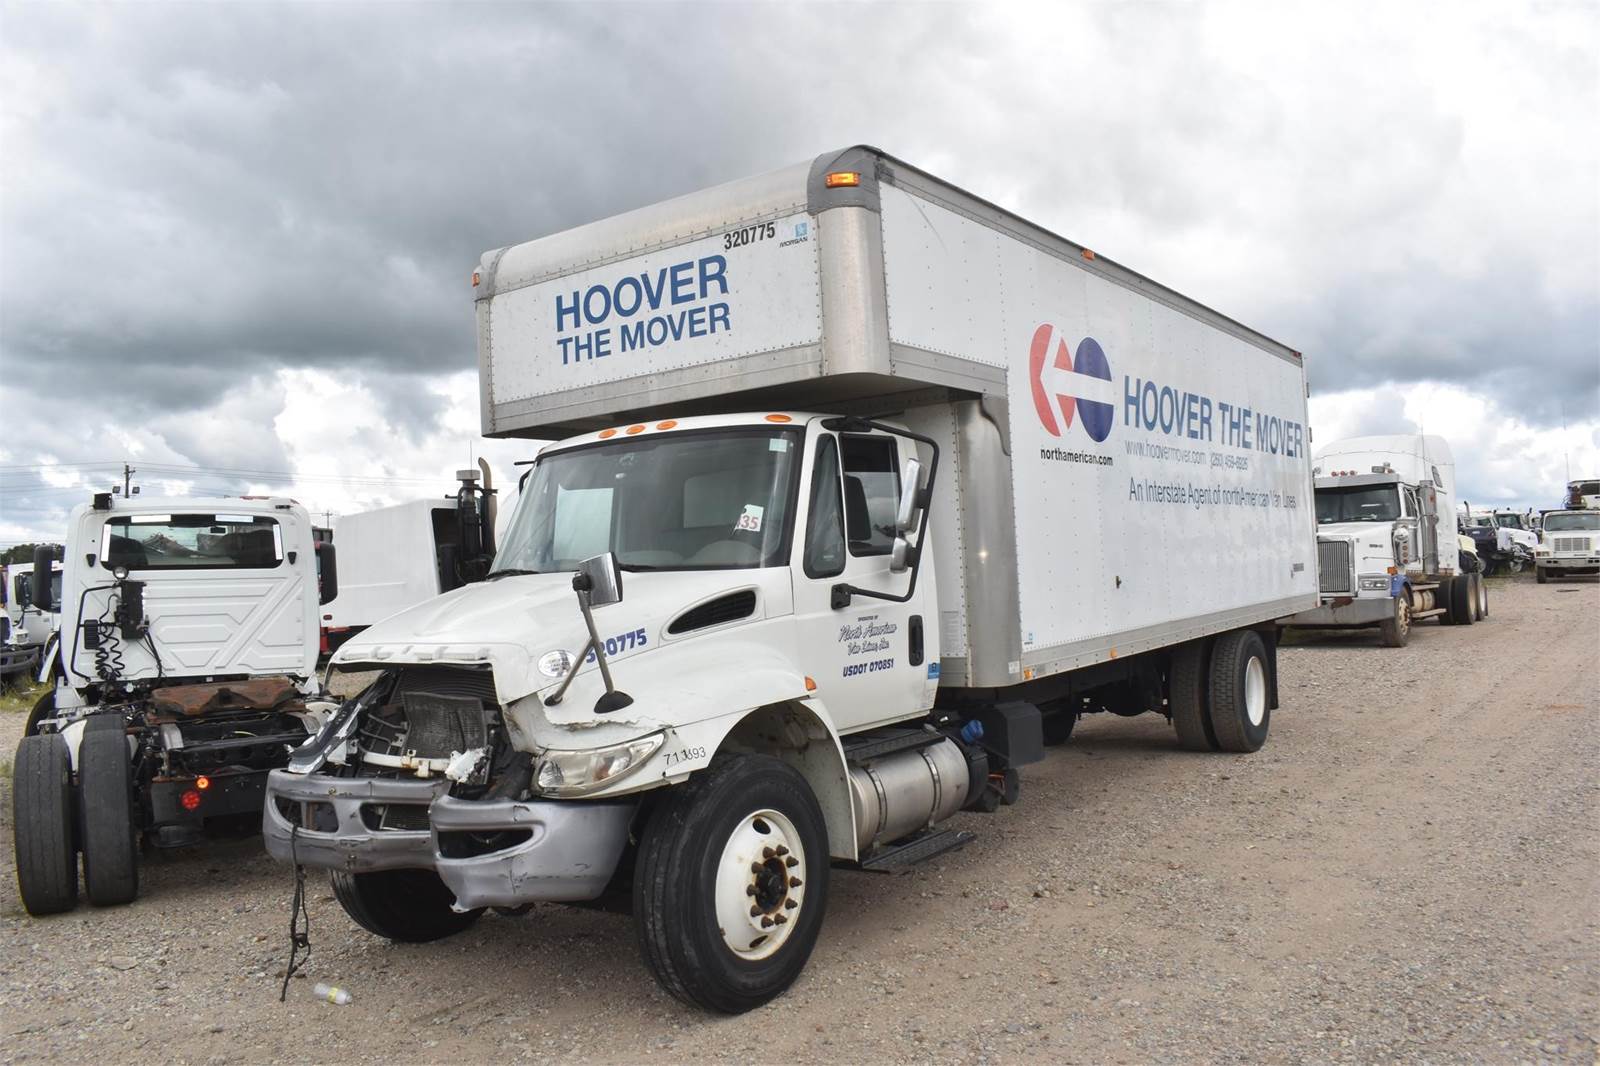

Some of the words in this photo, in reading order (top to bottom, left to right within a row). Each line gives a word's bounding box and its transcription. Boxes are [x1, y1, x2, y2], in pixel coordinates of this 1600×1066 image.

[724, 221, 775, 250] 320775
[780, 236, 808, 248] MORGAN
[556, 254, 729, 333] HOOVER
[557, 328, 611, 366] THE
[620, 302, 731, 353] MOVER
[1124, 375, 1212, 442] HOOVER
[1219, 402, 1252, 449] THE
[1256, 413, 1303, 459] MOVER
[1040, 447, 1114, 466] northamerican.com
[1129, 476, 1144, 502] An
[1145, 479, 1186, 504] Interstate
[1188, 483, 1213, 510] Agent
[1214, 484, 1221, 505] of
[843, 663, 868, 677] USDOT
[869, 658, 894, 673] 070851
